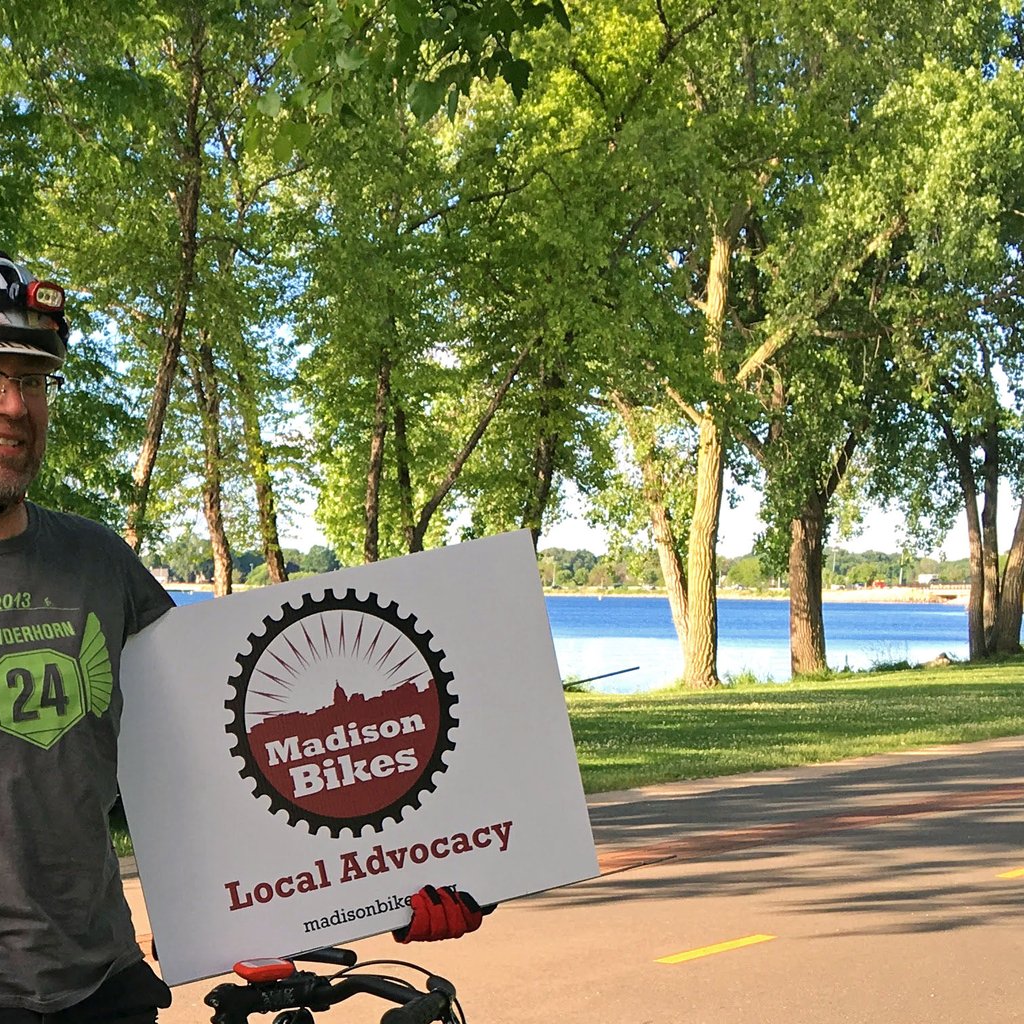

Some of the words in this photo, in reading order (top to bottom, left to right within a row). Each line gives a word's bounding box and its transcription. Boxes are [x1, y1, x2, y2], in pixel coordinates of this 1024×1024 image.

[6, 663, 70, 723] 24
[265, 713, 425, 766] Madison
[288, 748, 419, 798] Bikes
[224, 860, 332, 911] Local
[340, 821, 513, 883] Advocacy
[303, 883, 457, 933] madisonbike
